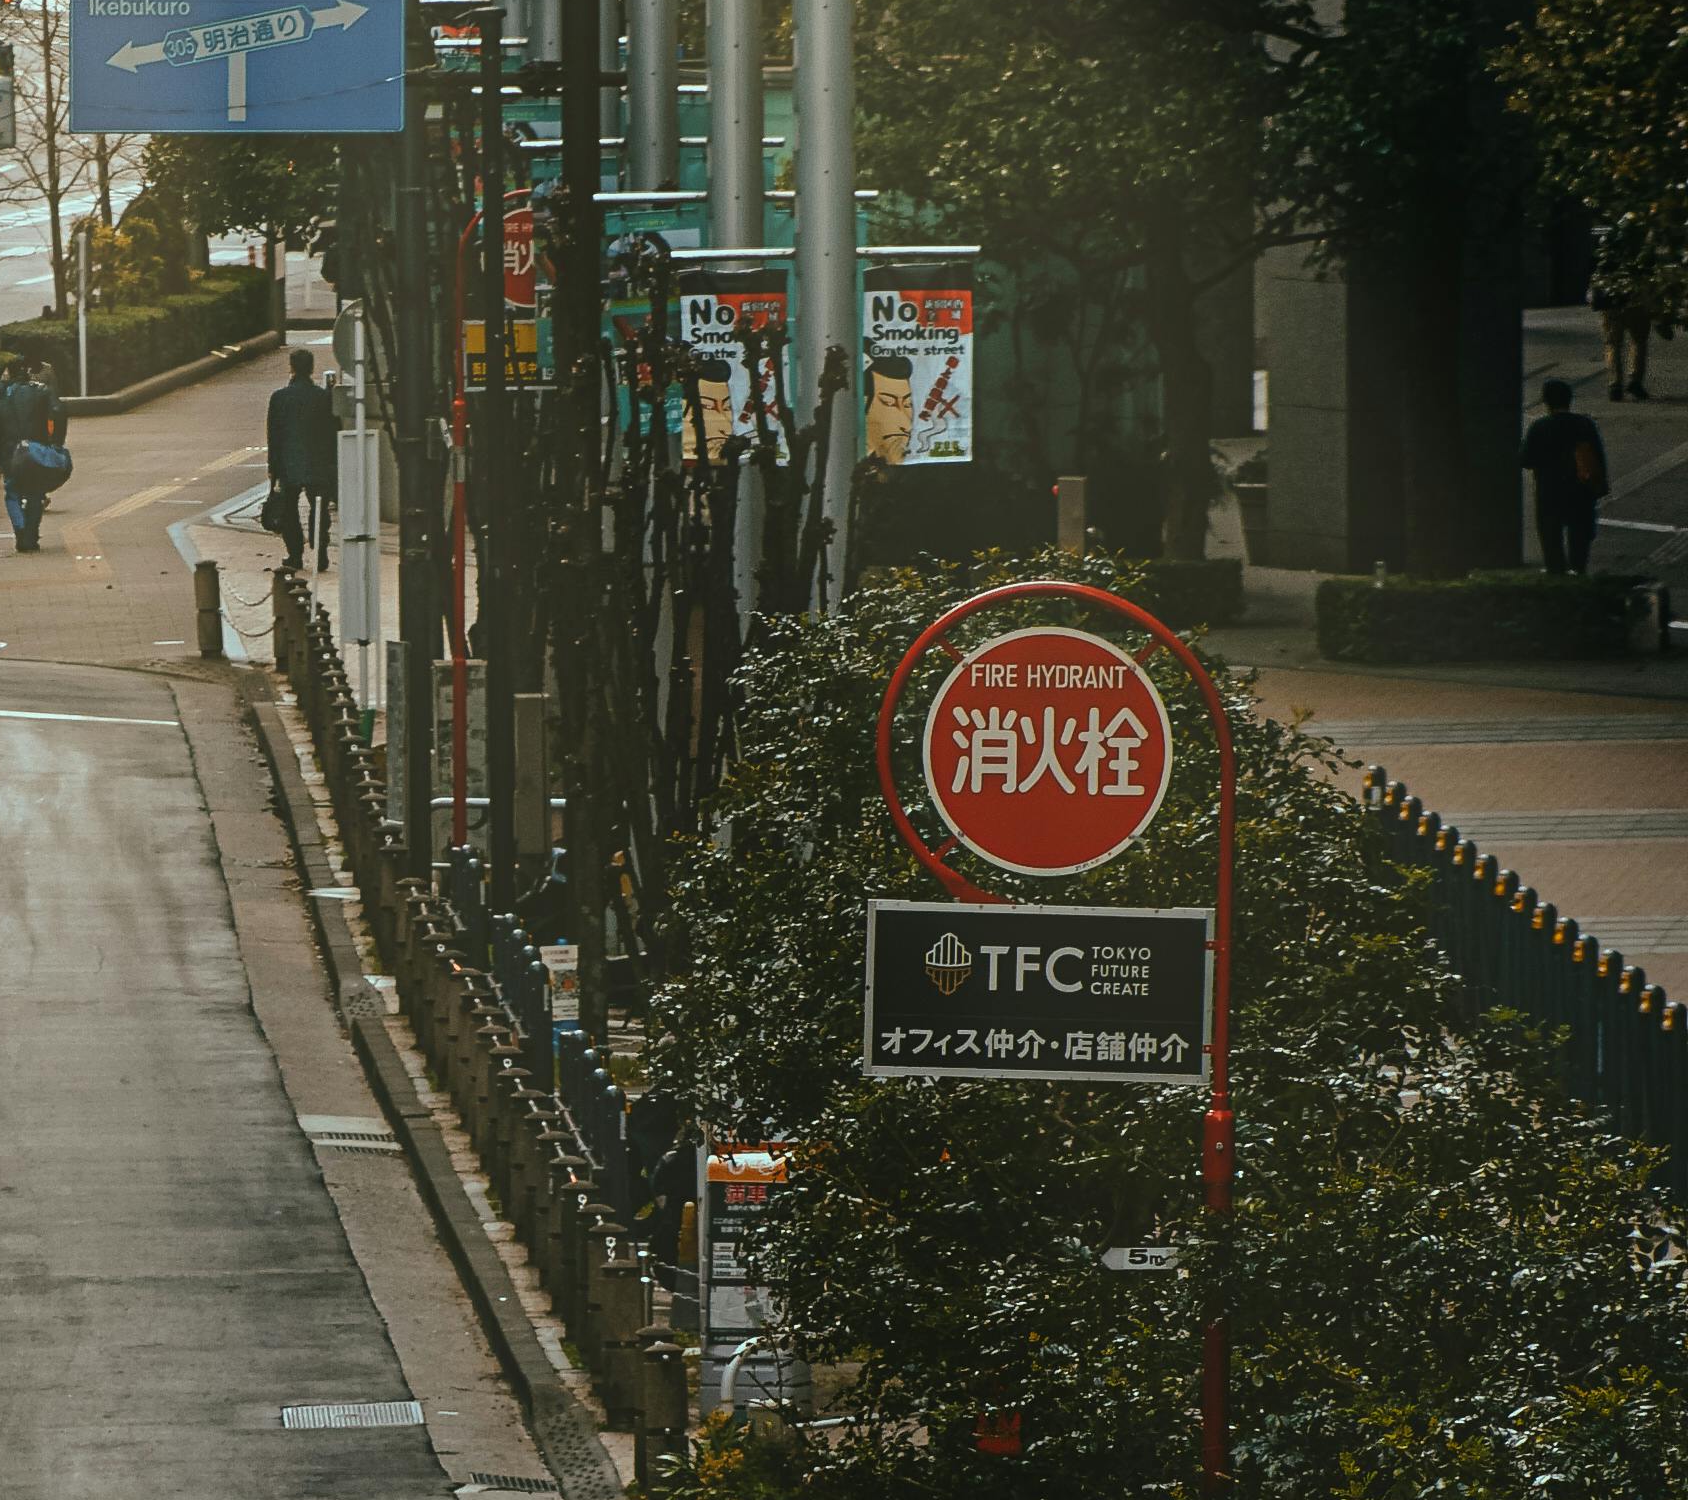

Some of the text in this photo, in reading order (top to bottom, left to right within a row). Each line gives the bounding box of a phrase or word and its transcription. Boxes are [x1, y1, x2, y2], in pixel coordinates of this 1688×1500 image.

[202, 14, 299, 53] 明治通り
[166, 37, 196, 59] 305
[690, 298, 736, 326] No
[872, 295, 918, 323] No
[871, 323, 960, 345] Smoking
[871, 345, 966, 357] On the street
[971, 663, 1128, 689] FIRE HYDRANT
[951, 706, 1149, 796] 消火栓
[1090, 946, 1152, 961] TOKYO
[979, 945, 1085, 993] TFC
[1090, 964, 1150, 979] FUTURE
[1090, 982, 1150, 996] CREATE
[881, 1026, 1190, 1064] オフィス仲介・店舗仲介
[724, 1184, 768, 1205] 満車
